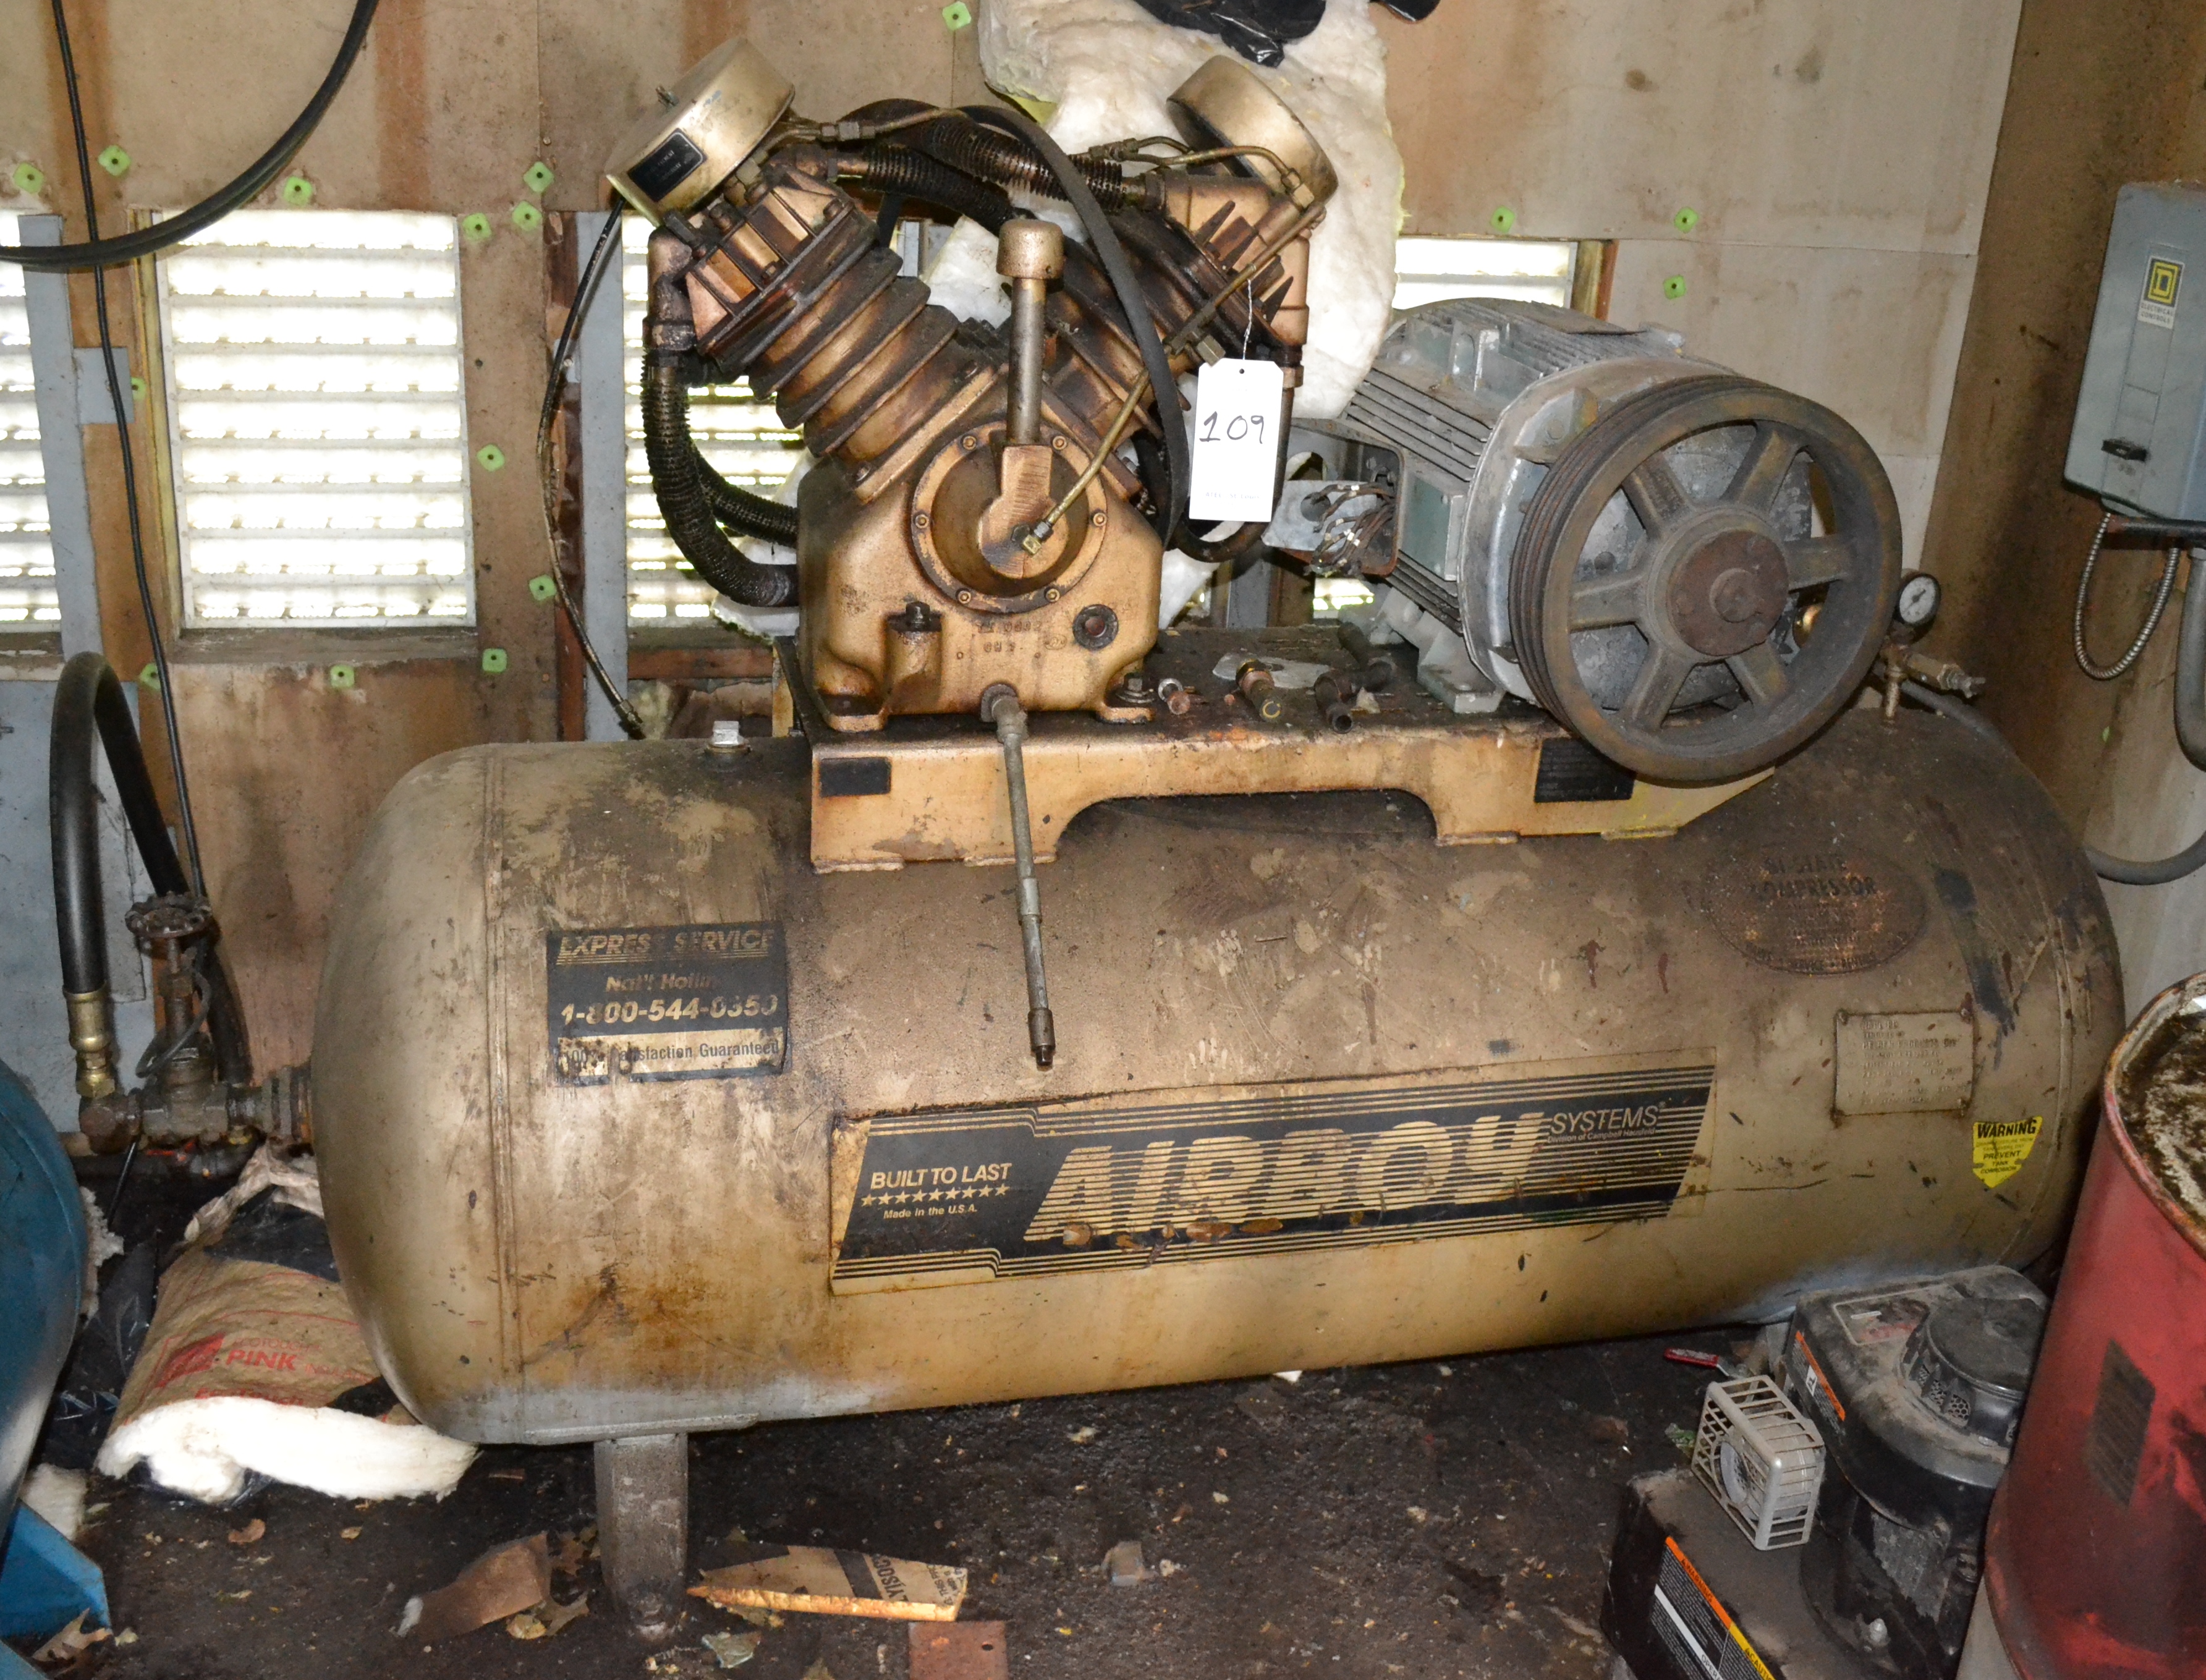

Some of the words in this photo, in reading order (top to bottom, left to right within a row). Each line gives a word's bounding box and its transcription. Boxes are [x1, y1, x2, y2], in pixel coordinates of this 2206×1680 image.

[1199, 410, 1264, 444] 109
[558, 932, 665, 957] EXPRES
[700, 1037, 779, 1058] Guaranteed
[1551, 1105, 1659, 1135] SYSTEMS
[1977, 1119, 2037, 1139] WARNING
[1983, 1150, 2021, 1160] PREVENT
[870, 1168, 928, 1189] BUILT
[931, 1166, 957, 1186] TO
[961, 1162, 1012, 1183] LAST
[883, 1208, 912, 1220] Made
[915, 1207, 925, 1216] in
[928, 1206, 944, 1216] the
[225, 1349, 297, 1371] PINK
[1702, 1654, 1721, 1680] OPER
